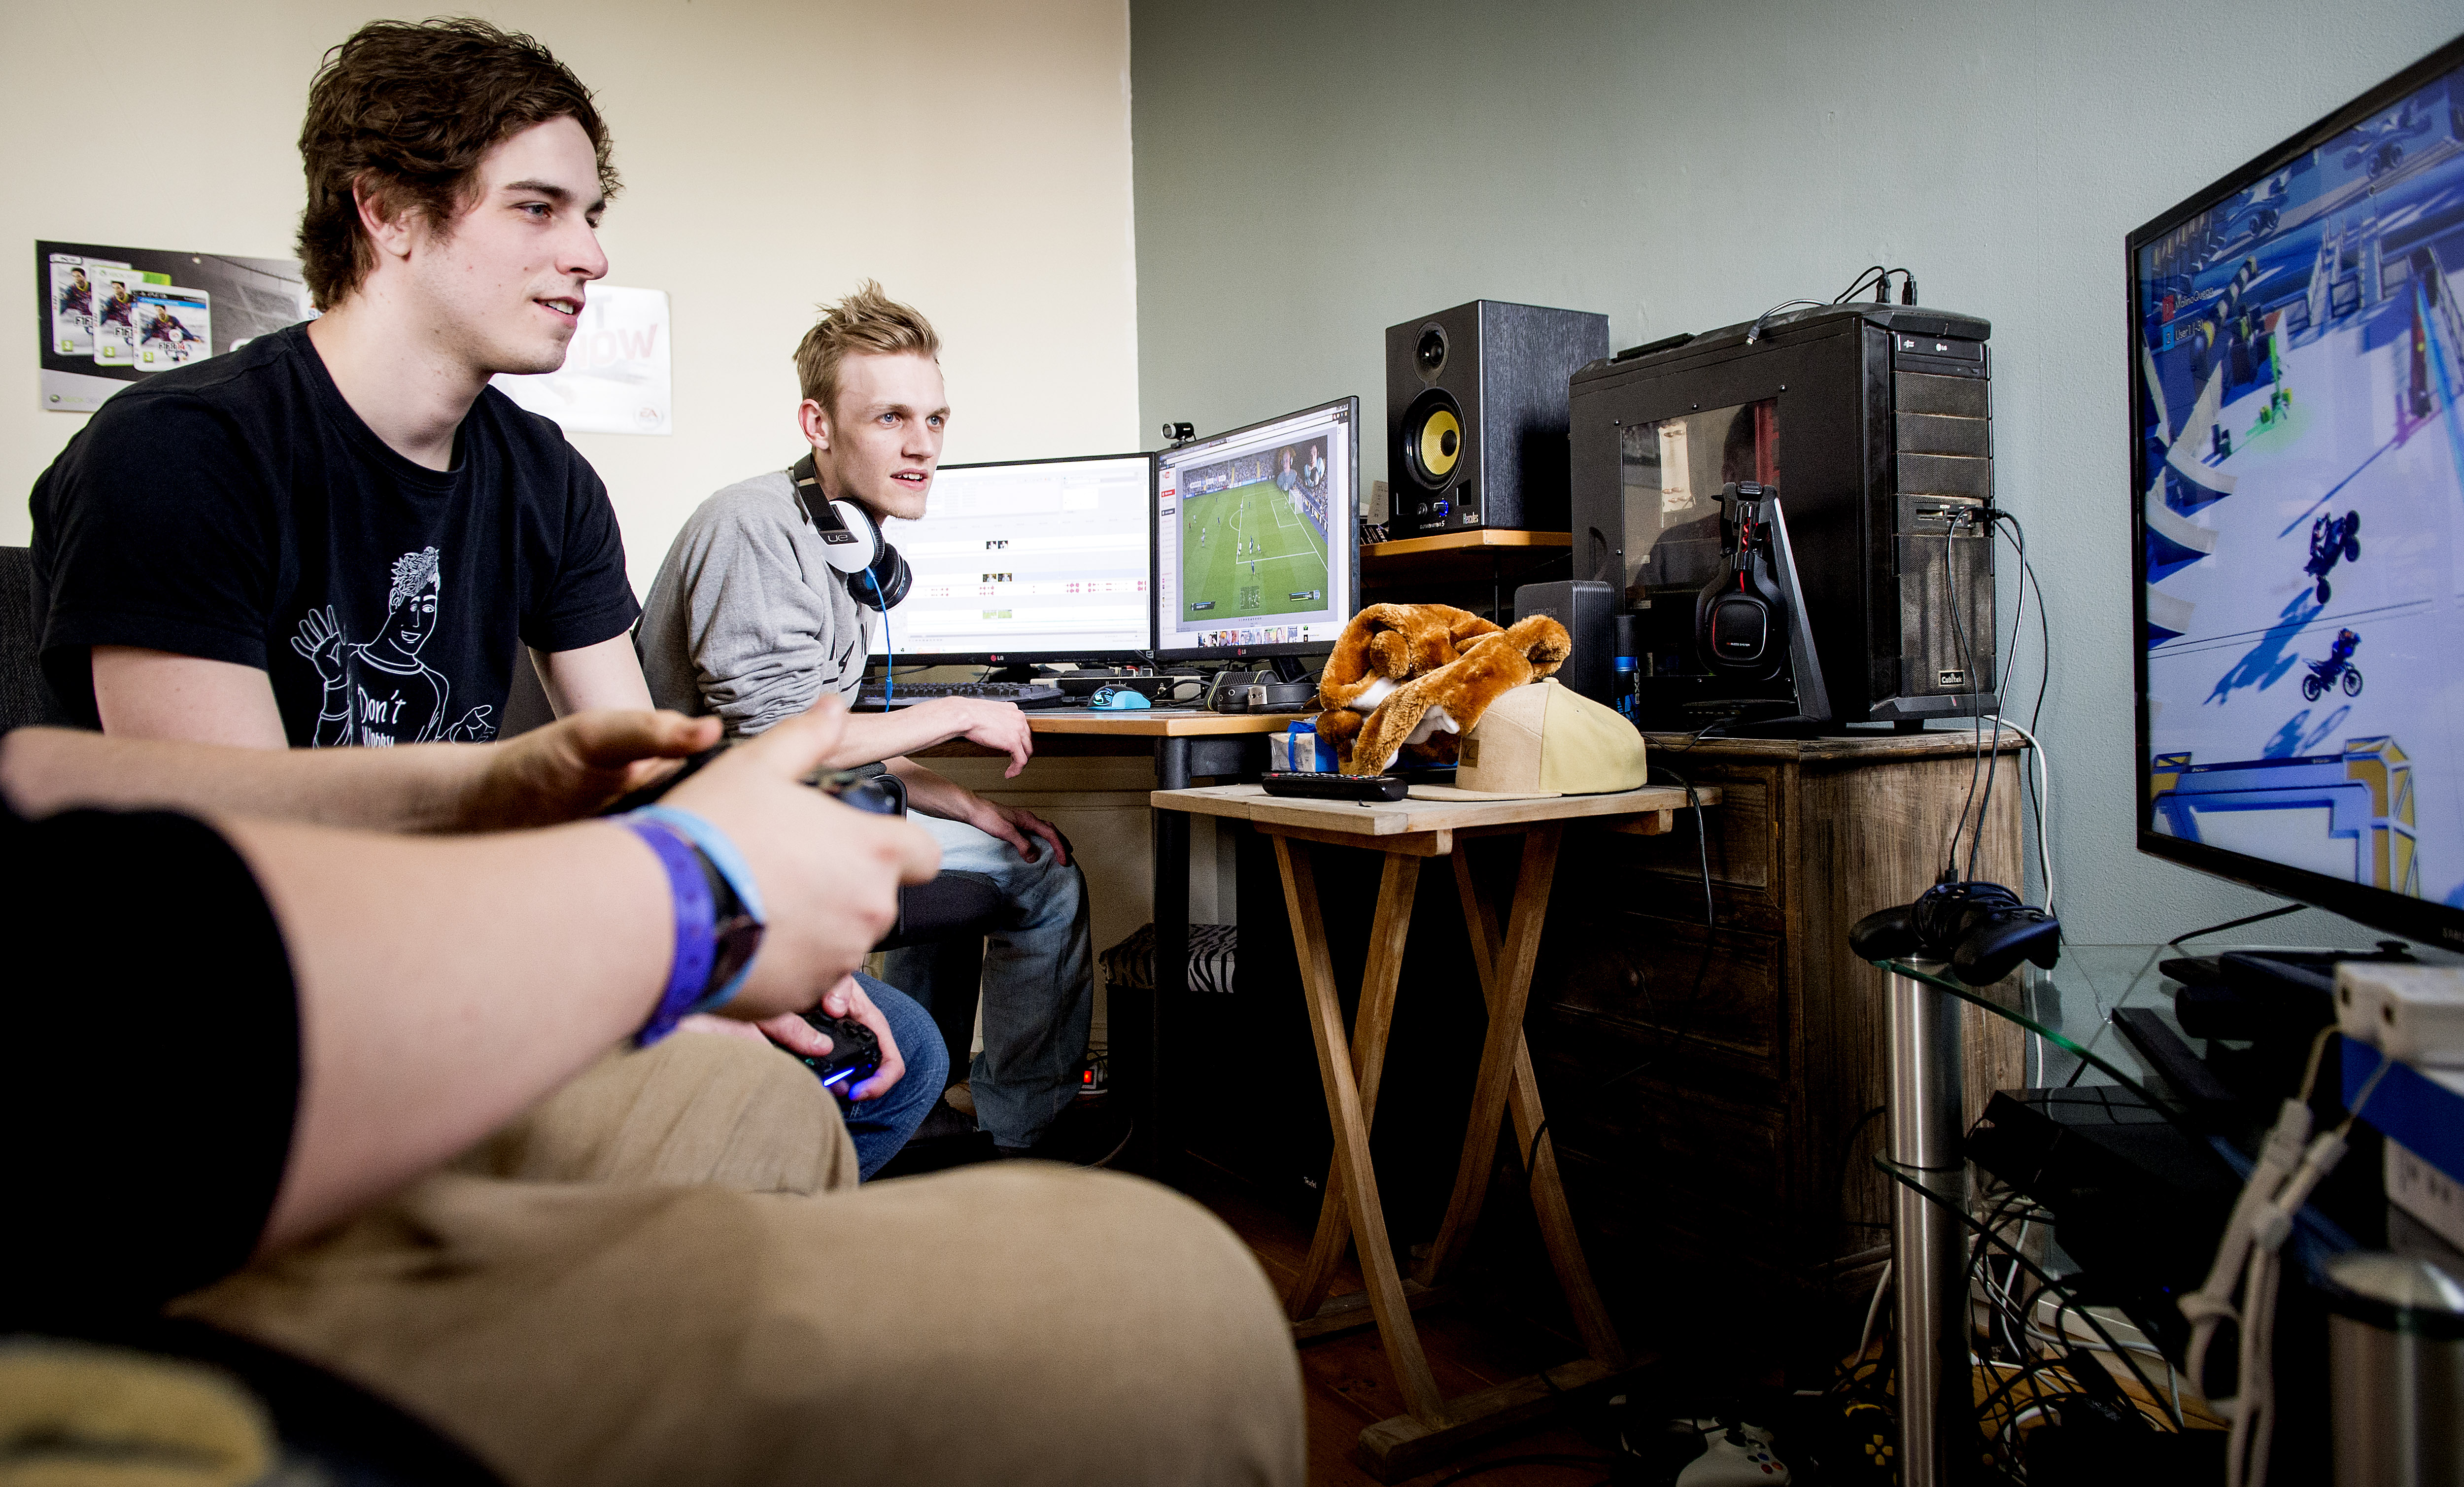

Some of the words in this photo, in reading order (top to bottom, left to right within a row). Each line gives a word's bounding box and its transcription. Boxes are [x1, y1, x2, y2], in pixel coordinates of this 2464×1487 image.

[75, 315, 93, 325] FIF
[115, 327, 132, 336] FIF
[1463, 511, 1478, 524] Hercules
[1941, 673, 1962, 684] Cubitek
[357, 683, 407, 725] Don't
